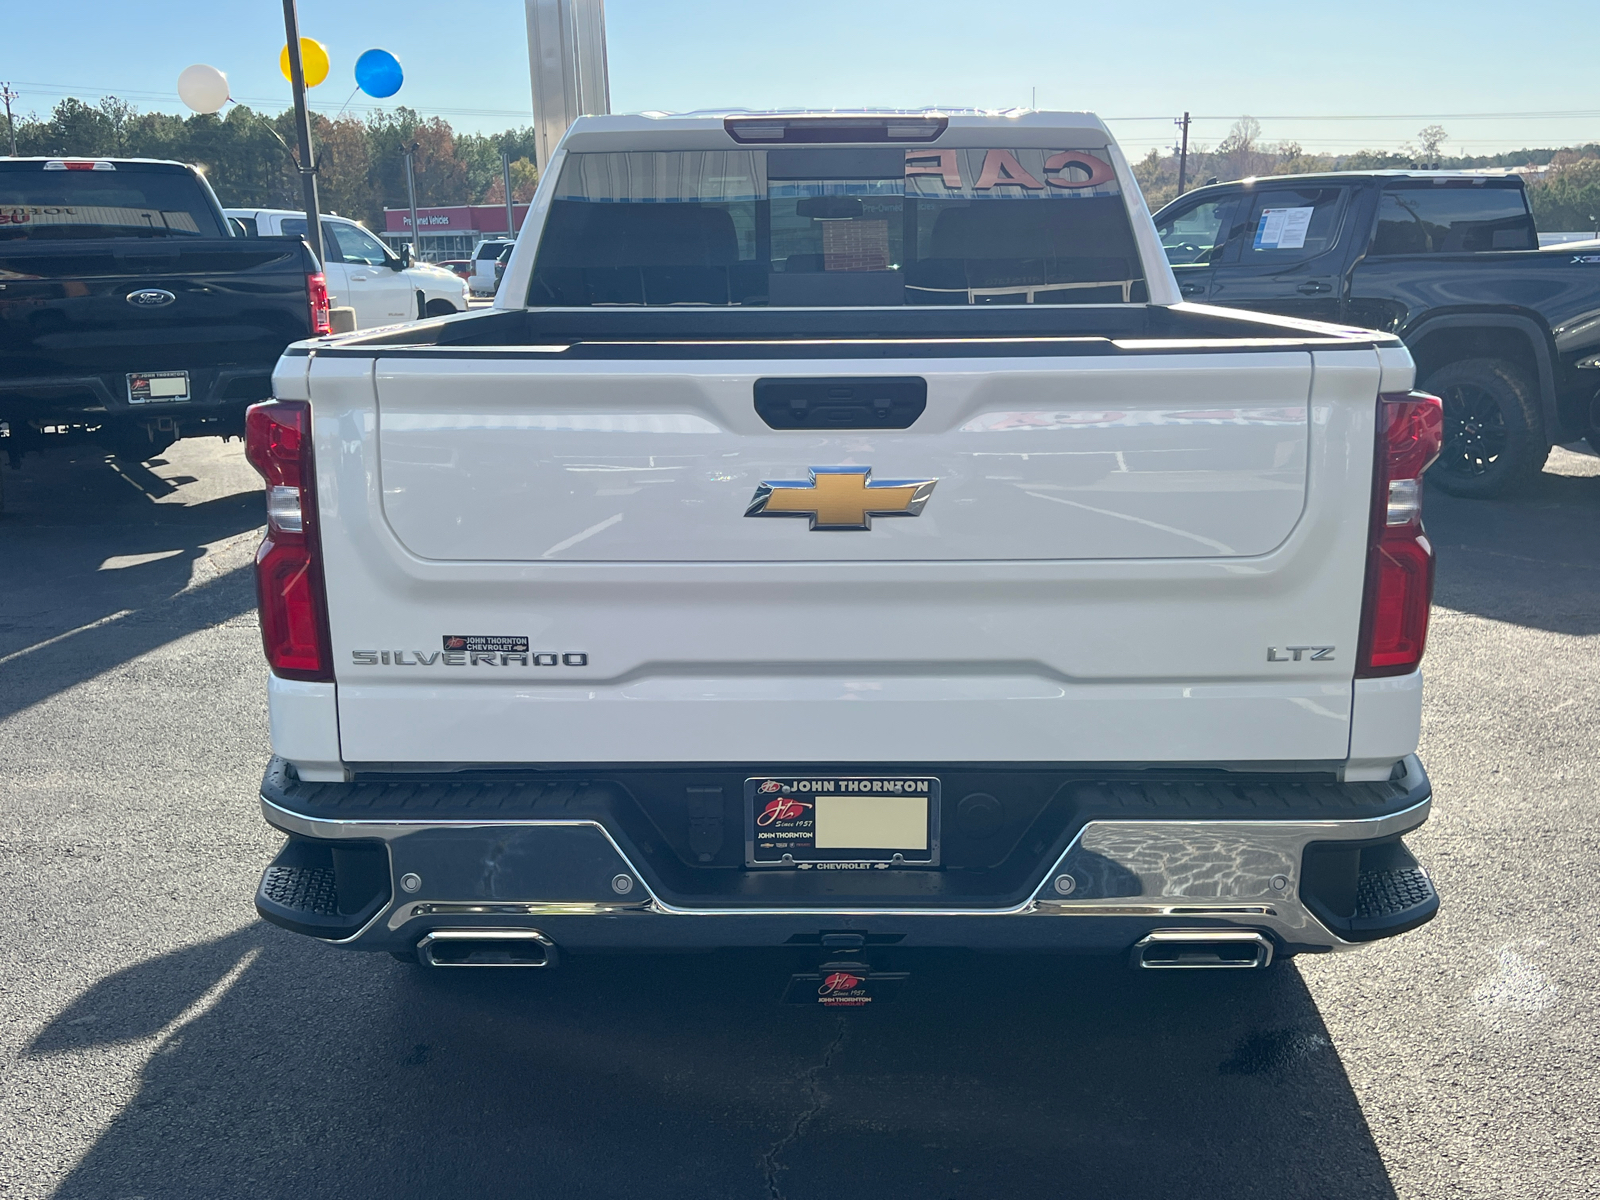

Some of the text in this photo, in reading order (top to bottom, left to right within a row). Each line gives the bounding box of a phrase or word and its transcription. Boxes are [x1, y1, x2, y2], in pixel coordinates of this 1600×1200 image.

[429, 215, 449, 225] Vehicles
[486, 637, 527, 645] THORNTON
[352, 650, 589, 666] SILVERADO
[1267, 645, 1336, 662] LTZ
[791, 781, 835, 792] JOHN
[839, 780, 929, 792] THORNTON
[775, 831, 813, 839] THORNTON
